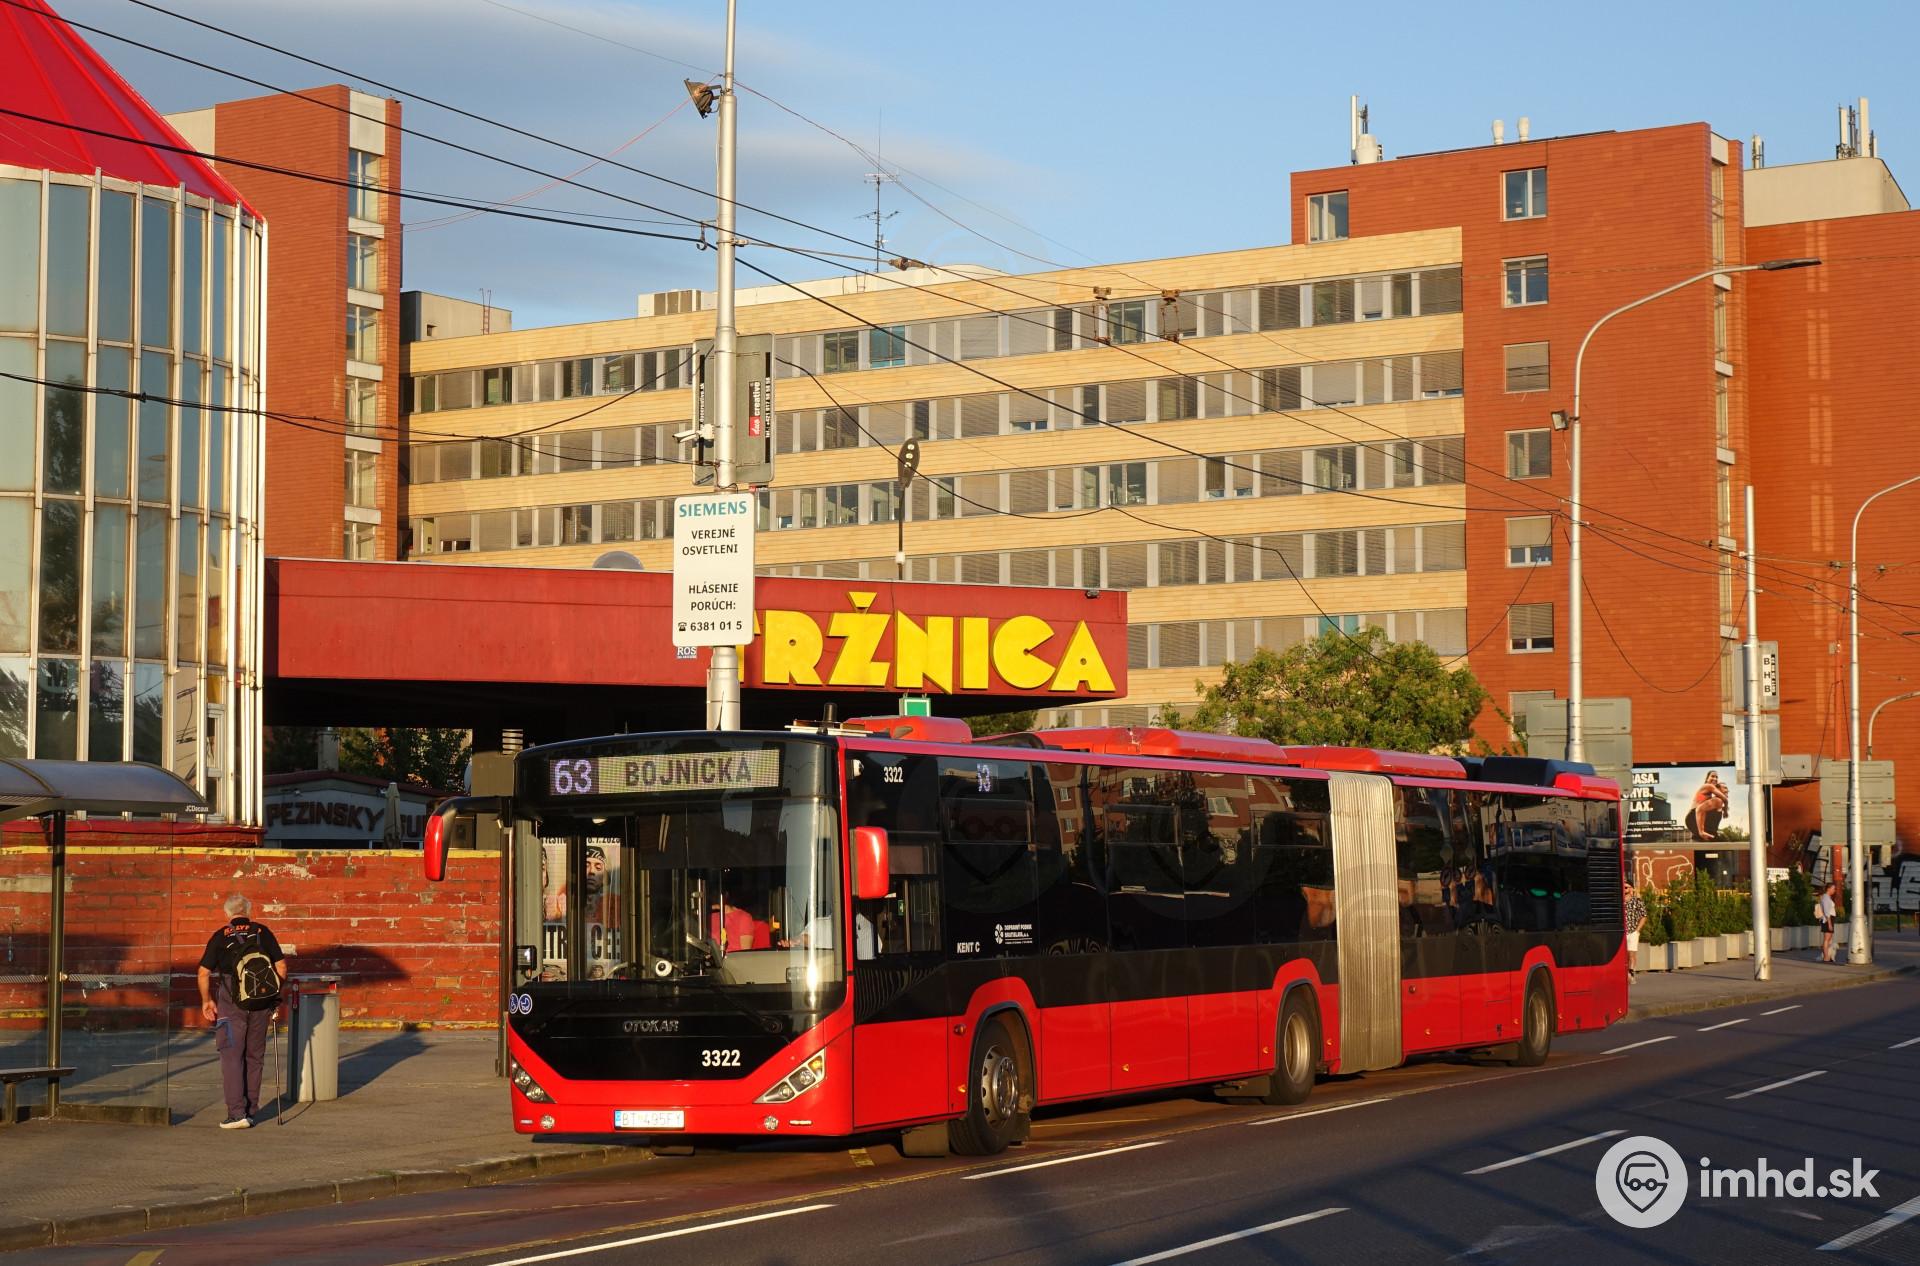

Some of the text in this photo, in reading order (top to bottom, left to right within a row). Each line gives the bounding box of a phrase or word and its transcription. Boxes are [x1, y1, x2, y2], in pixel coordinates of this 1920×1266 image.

[753, 381, 761, 416] creative
[679, 500, 747, 517] SIEMENS
[691, 525, 736, 539] VEREJNÉ
[688, 581, 739, 594] HLÁSENIE
[690, 597, 736, 611] PORÚCH:
[690, 620, 742, 632] 6381 01 5
[739, 591, 1116, 695] RŽNICA
[677, 646, 697, 655] ROS
[554, 759, 592, 795] 63
[883, 766, 904, 783] 3322
[956, 941, 981, 954] KENT C
[623, 1019, 680, 1033] OTOKAR
[701, 1049, 741, 1067] 3322
